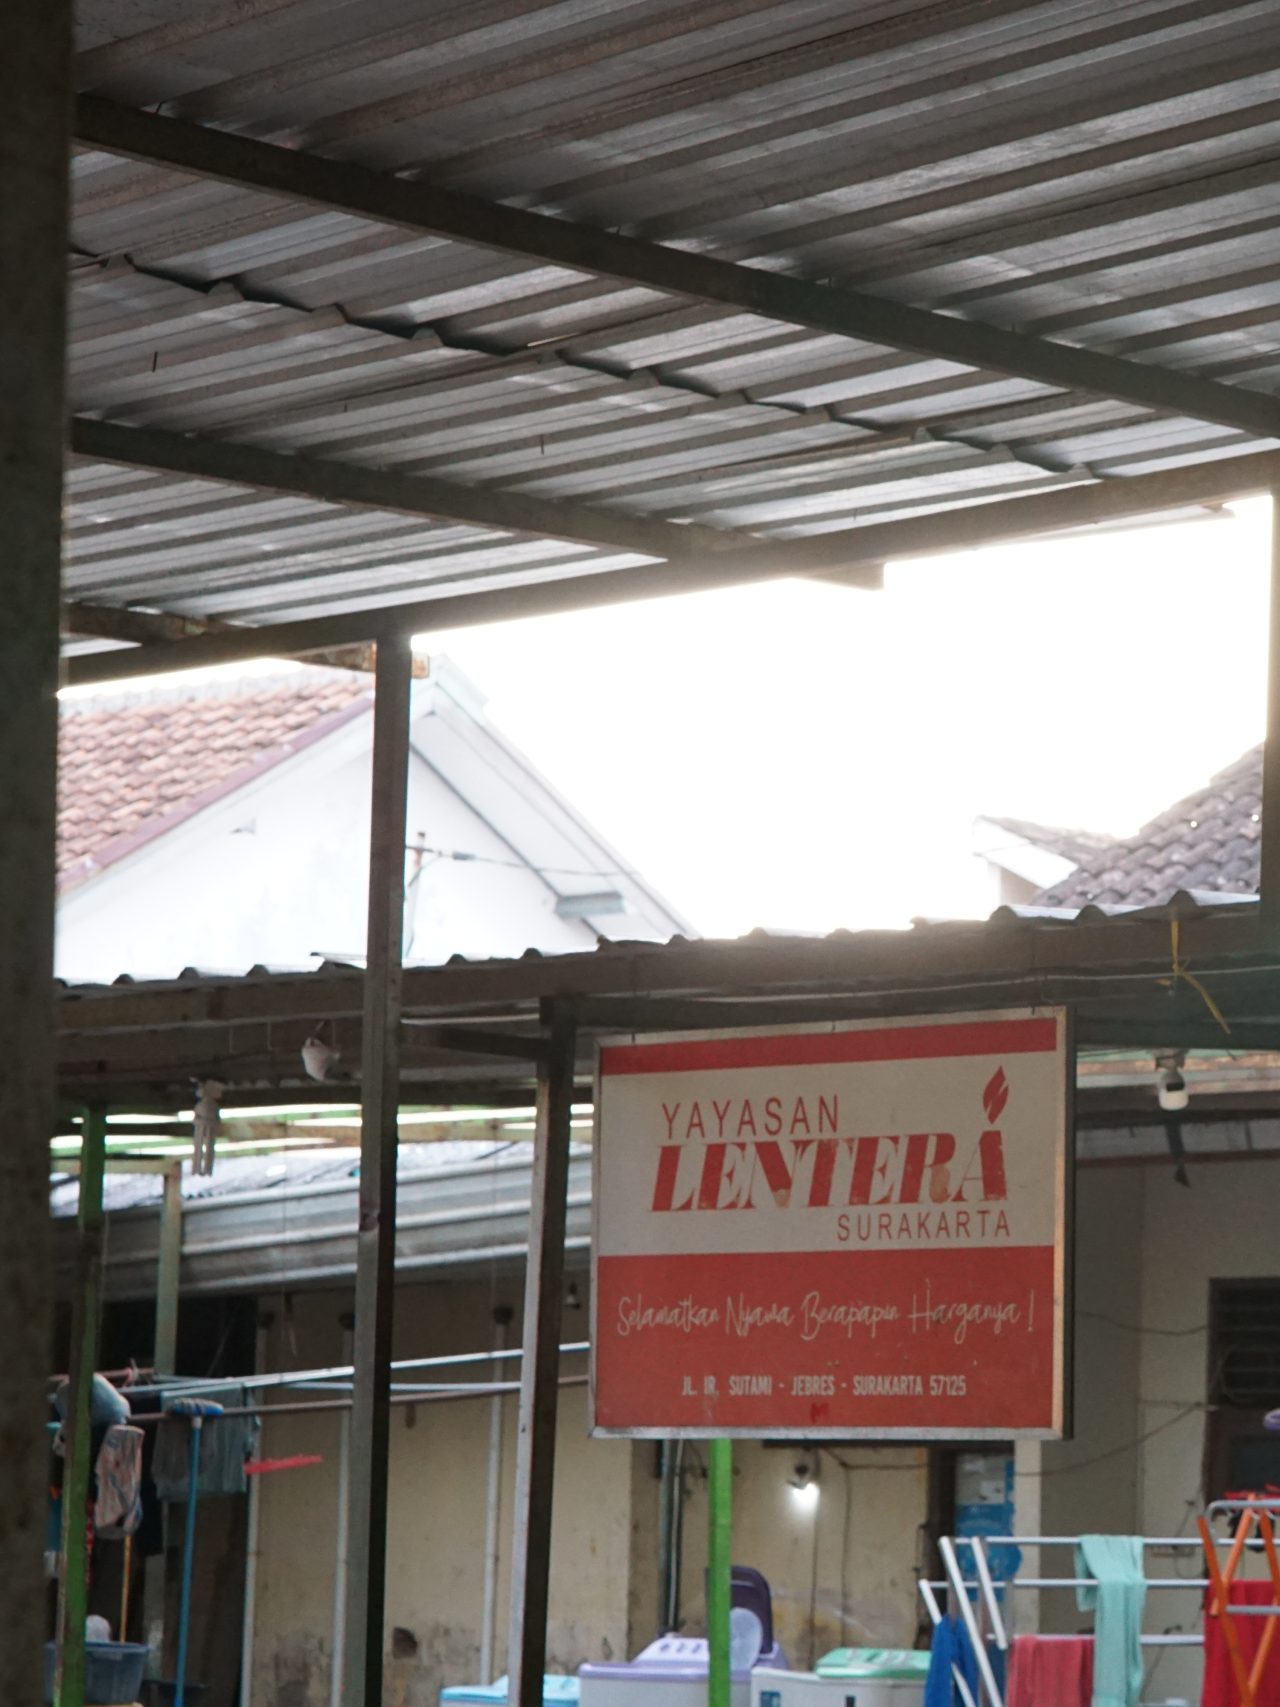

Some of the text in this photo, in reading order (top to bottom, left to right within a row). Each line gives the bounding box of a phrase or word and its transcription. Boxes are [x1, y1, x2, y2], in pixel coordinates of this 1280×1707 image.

[661, 1094, 839, 1139] YAYASAN
[650, 1130, 1010, 1212] LENTERA
[836, 1209, 1011, 1241] SURAKARTA
[616, 1292, 720, 1337] Selamatkan
[724, 1291, 795, 1338] Nyawa
[799, 1290, 899, 1341] Berapapun
[907, 1288, 1021, 1344] Harganya
[728, 1375, 773, 1396] SUTAMI
[790, 1375, 835, 1396] JEBRES
[852, 1375, 924, 1396] SURAKARTA
[929, 1374, 967, 1396] 57125
